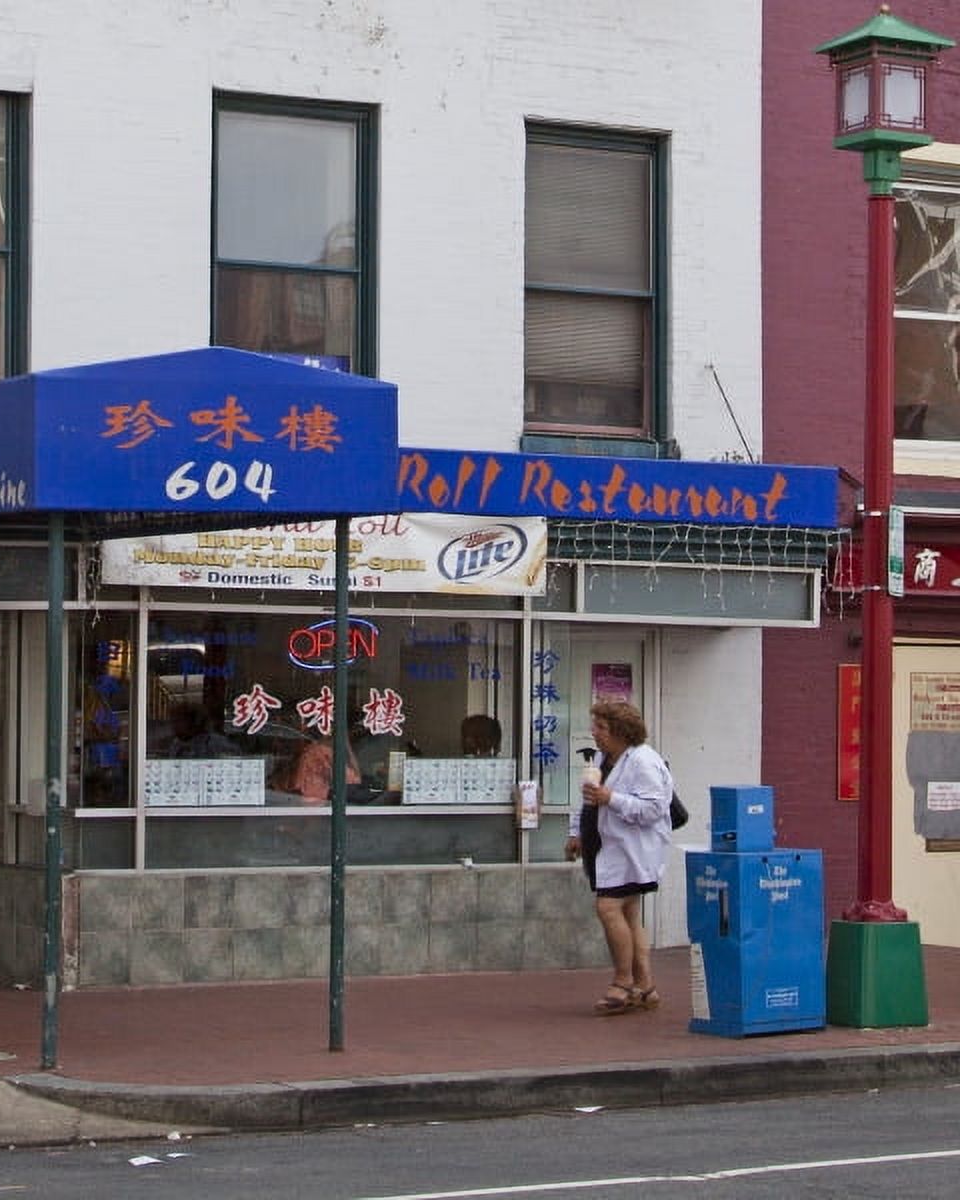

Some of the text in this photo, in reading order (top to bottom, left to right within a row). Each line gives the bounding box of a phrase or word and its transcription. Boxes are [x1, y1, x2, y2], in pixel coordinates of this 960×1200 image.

[100, 395, 342, 453] 珍味樓
[165, 460, 276, 503] 604
[397, 453, 788, 522] Roll Restaurant
[196, 533, 284, 550] HAPPY
[346, 513, 409, 537] oll
[207, 570, 292, 586] Domestic
[454, 539, 515, 580] Lite
[232, 684, 407, 738] 珍味樓
[534, 650, 561, 767] 珍珠奶茶
